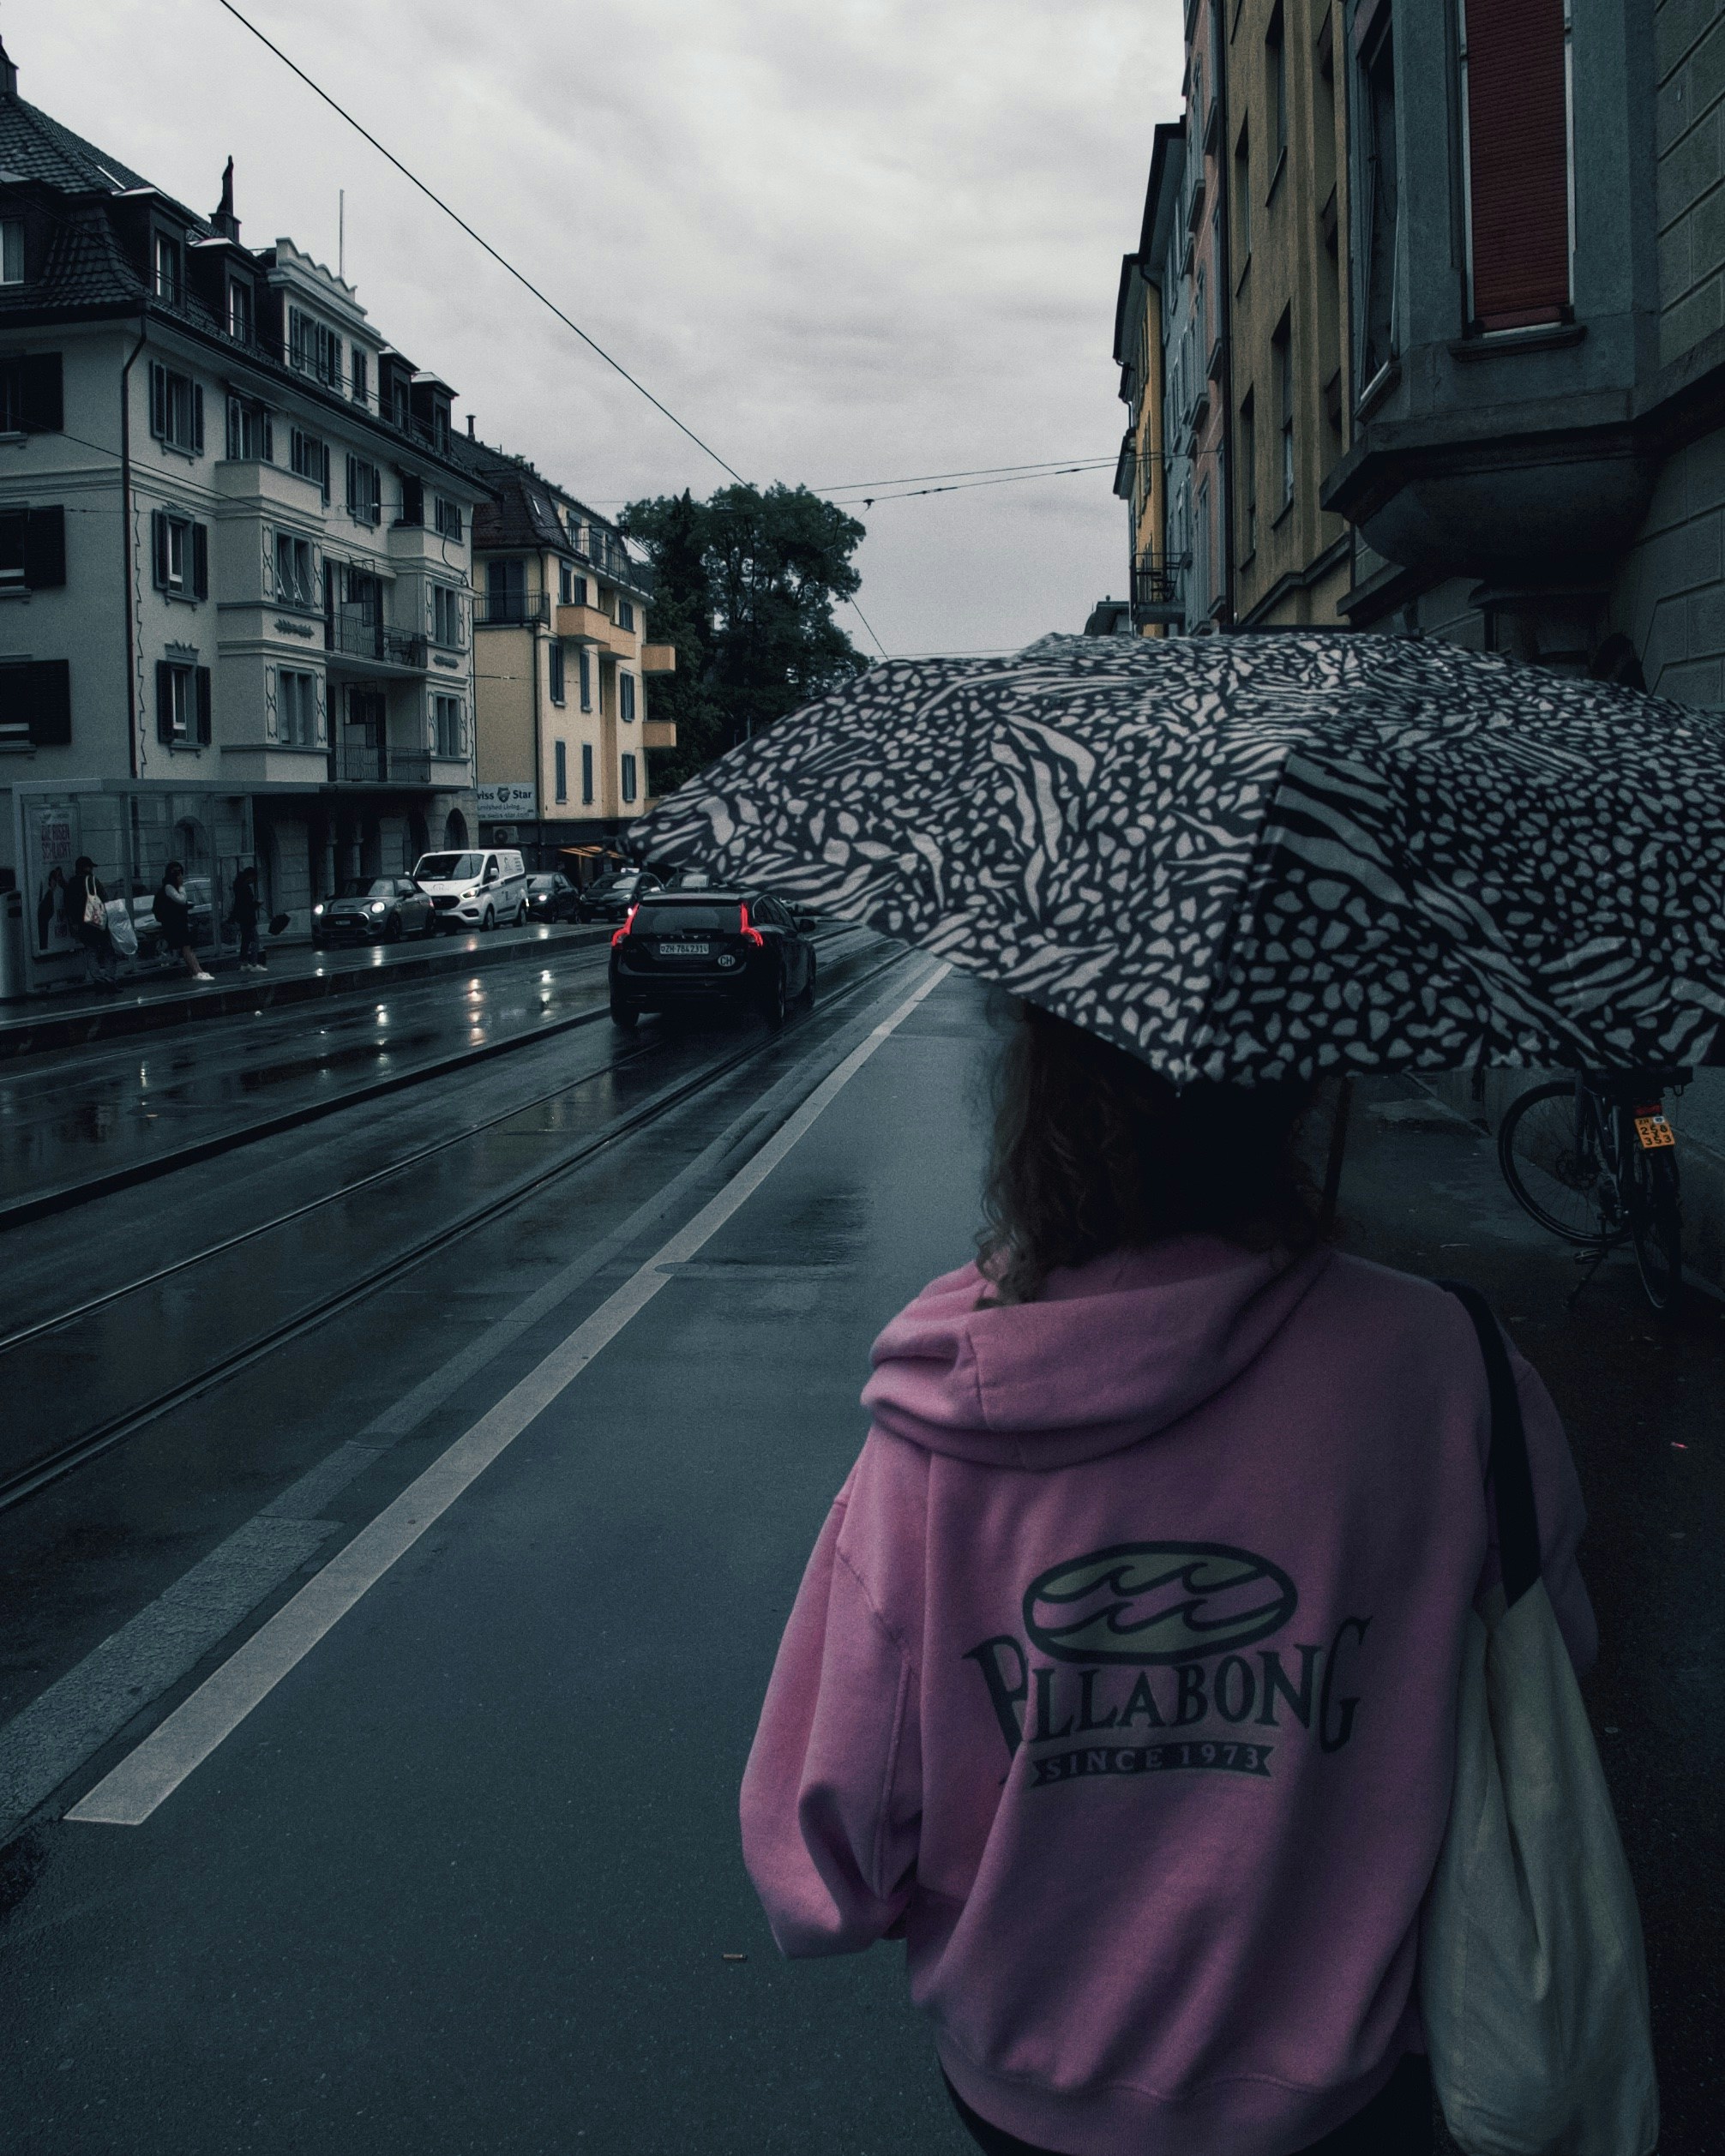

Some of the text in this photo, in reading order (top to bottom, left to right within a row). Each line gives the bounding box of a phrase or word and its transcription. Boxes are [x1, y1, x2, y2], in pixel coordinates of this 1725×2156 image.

[513, 790, 532, 799] Star
[720, 956, 732, 965] CH
[1045, 1742, 1259, 1781] SINCE 1973
